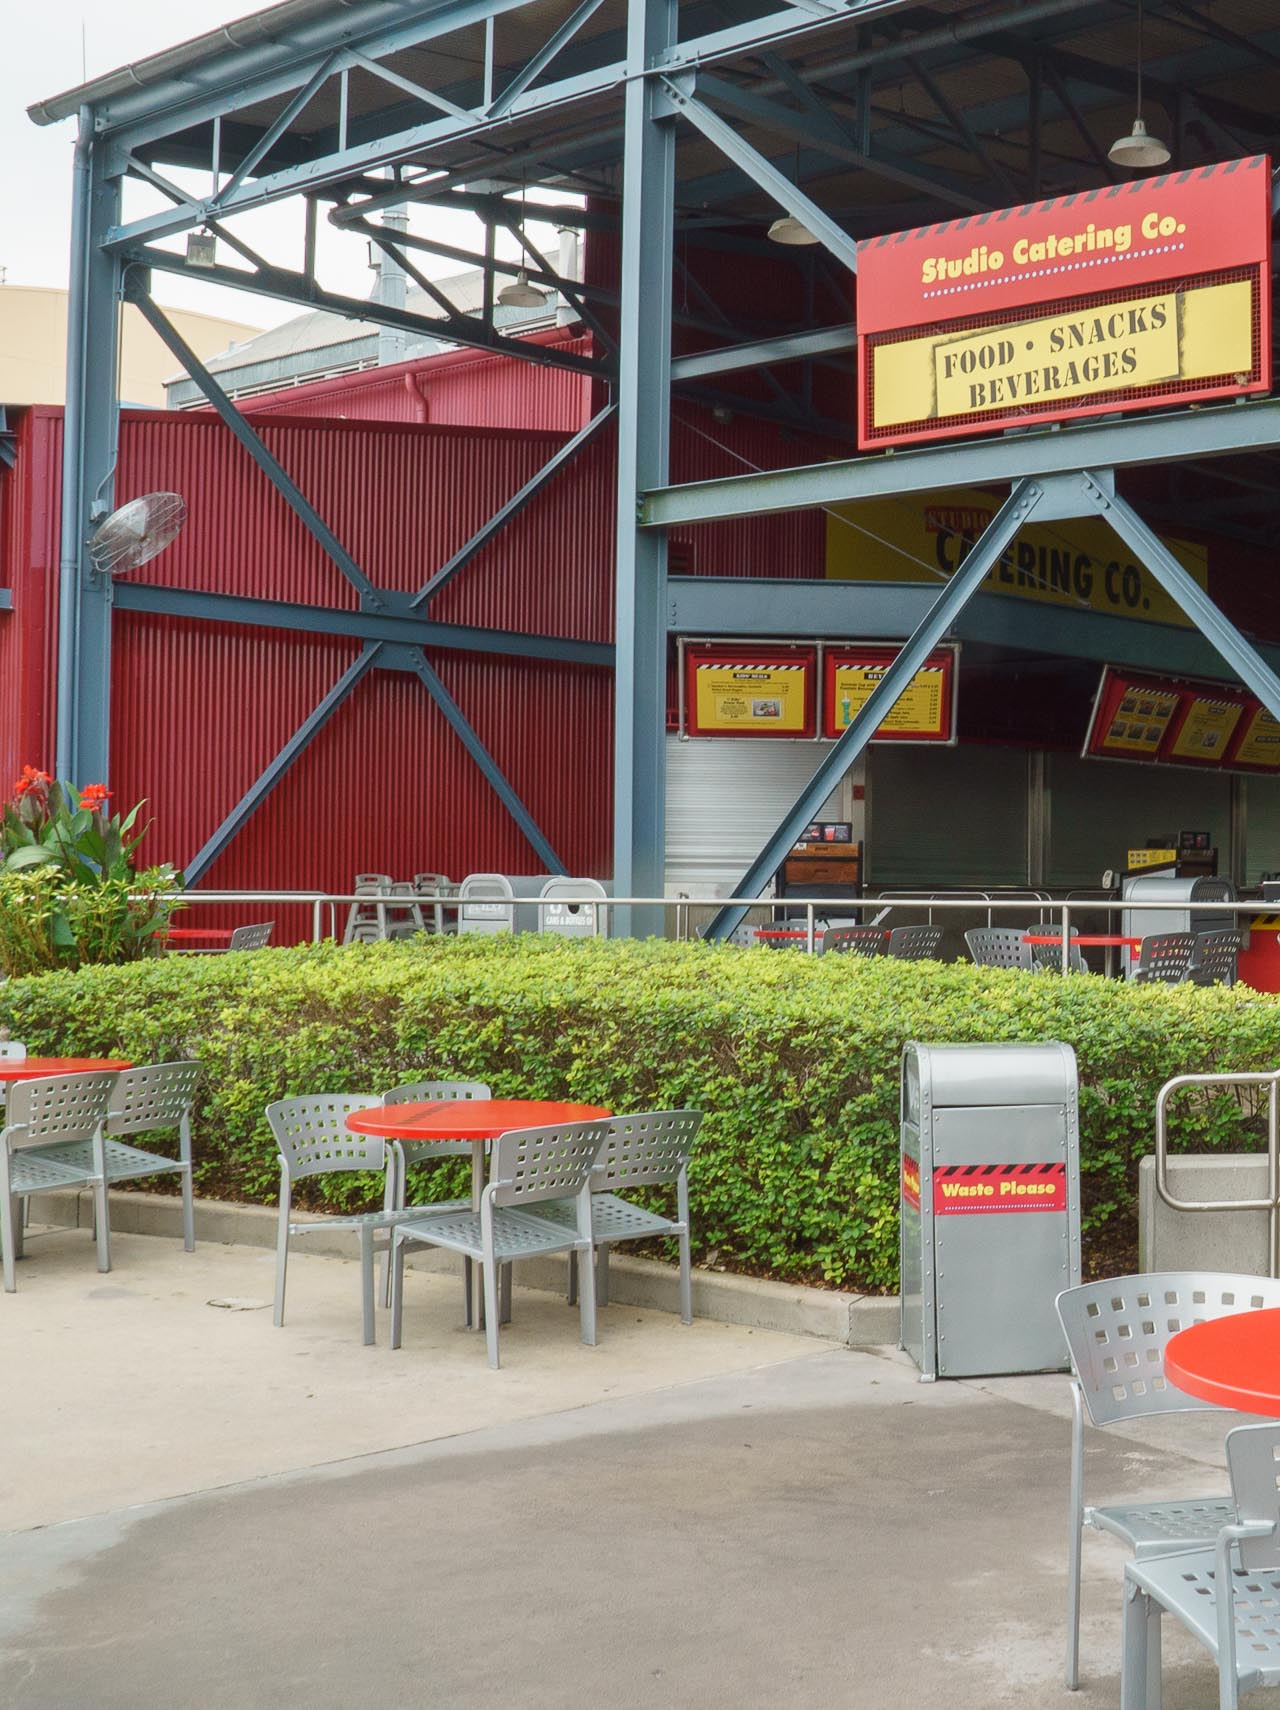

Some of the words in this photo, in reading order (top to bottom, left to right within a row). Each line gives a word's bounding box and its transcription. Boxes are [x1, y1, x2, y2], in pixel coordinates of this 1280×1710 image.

[921, 245, 1004, 284] Studio
[1012, 222, 1132, 266] Catering
[1141, 211, 1187, 240] Co.
[943, 338, 1015, 379] FOOD
[1049, 302, 1168, 354] SNACKS
[968, 346, 1138, 409] BEVERAGES
[1104, 560, 1150, 610] CO.
[941, 1183, 995, 1197] Waste
[1000, 1181, 1056, 1196] Please
